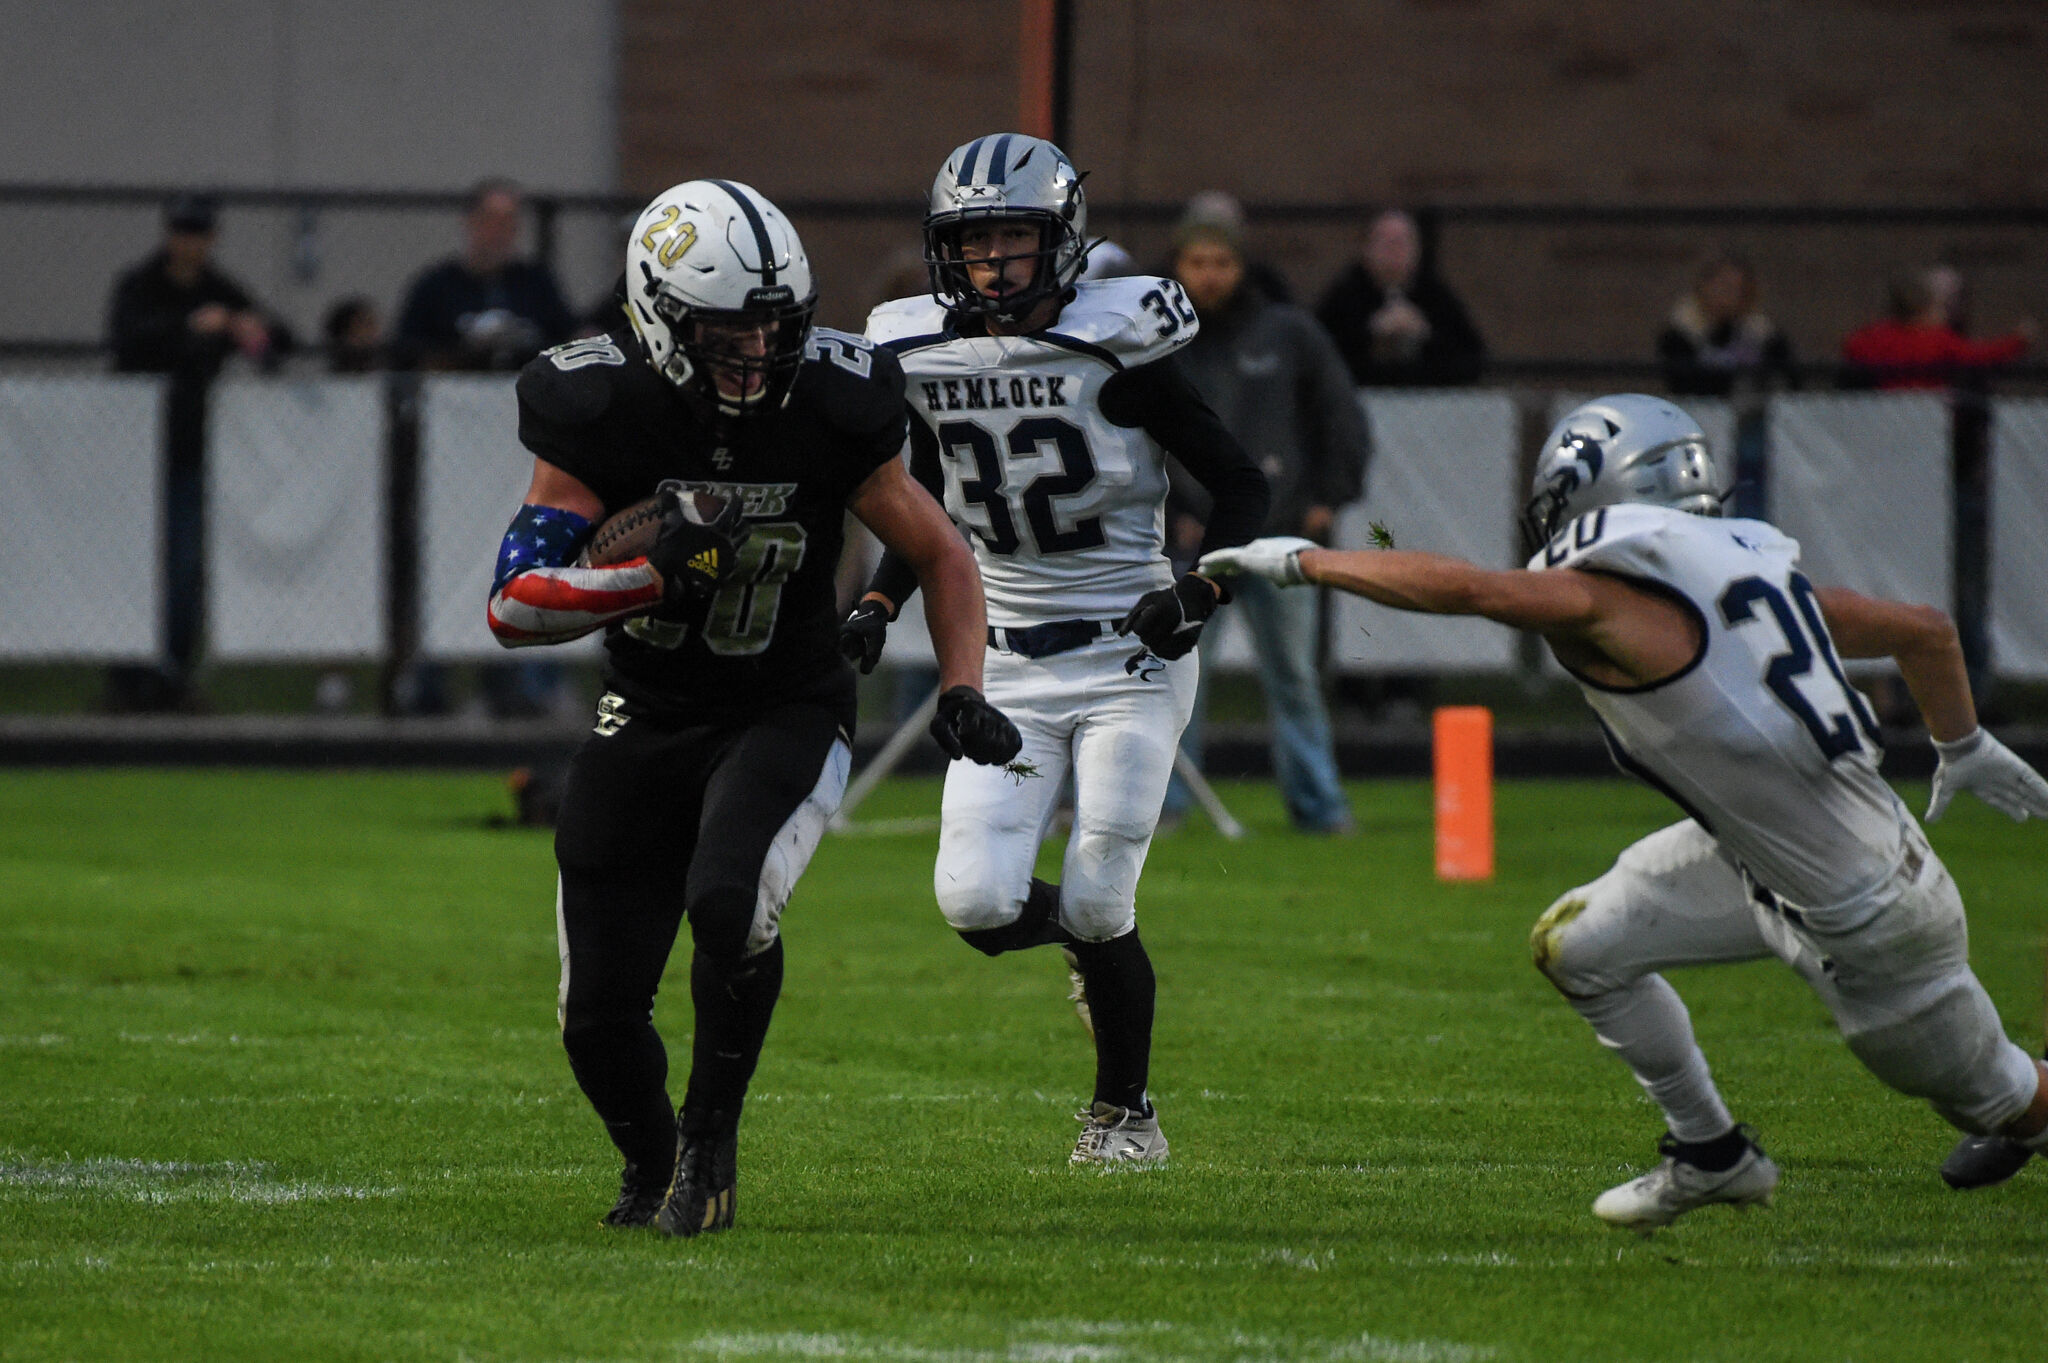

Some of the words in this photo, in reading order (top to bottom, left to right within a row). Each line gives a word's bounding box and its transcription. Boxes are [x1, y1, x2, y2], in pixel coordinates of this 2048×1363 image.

[641, 204, 698, 270] 20
[1139, 280, 1196, 339] 32
[921, 376, 1066, 411] HEMLOCK
[938, 416, 1109, 556] 32
[623, 522, 808, 655] 0
